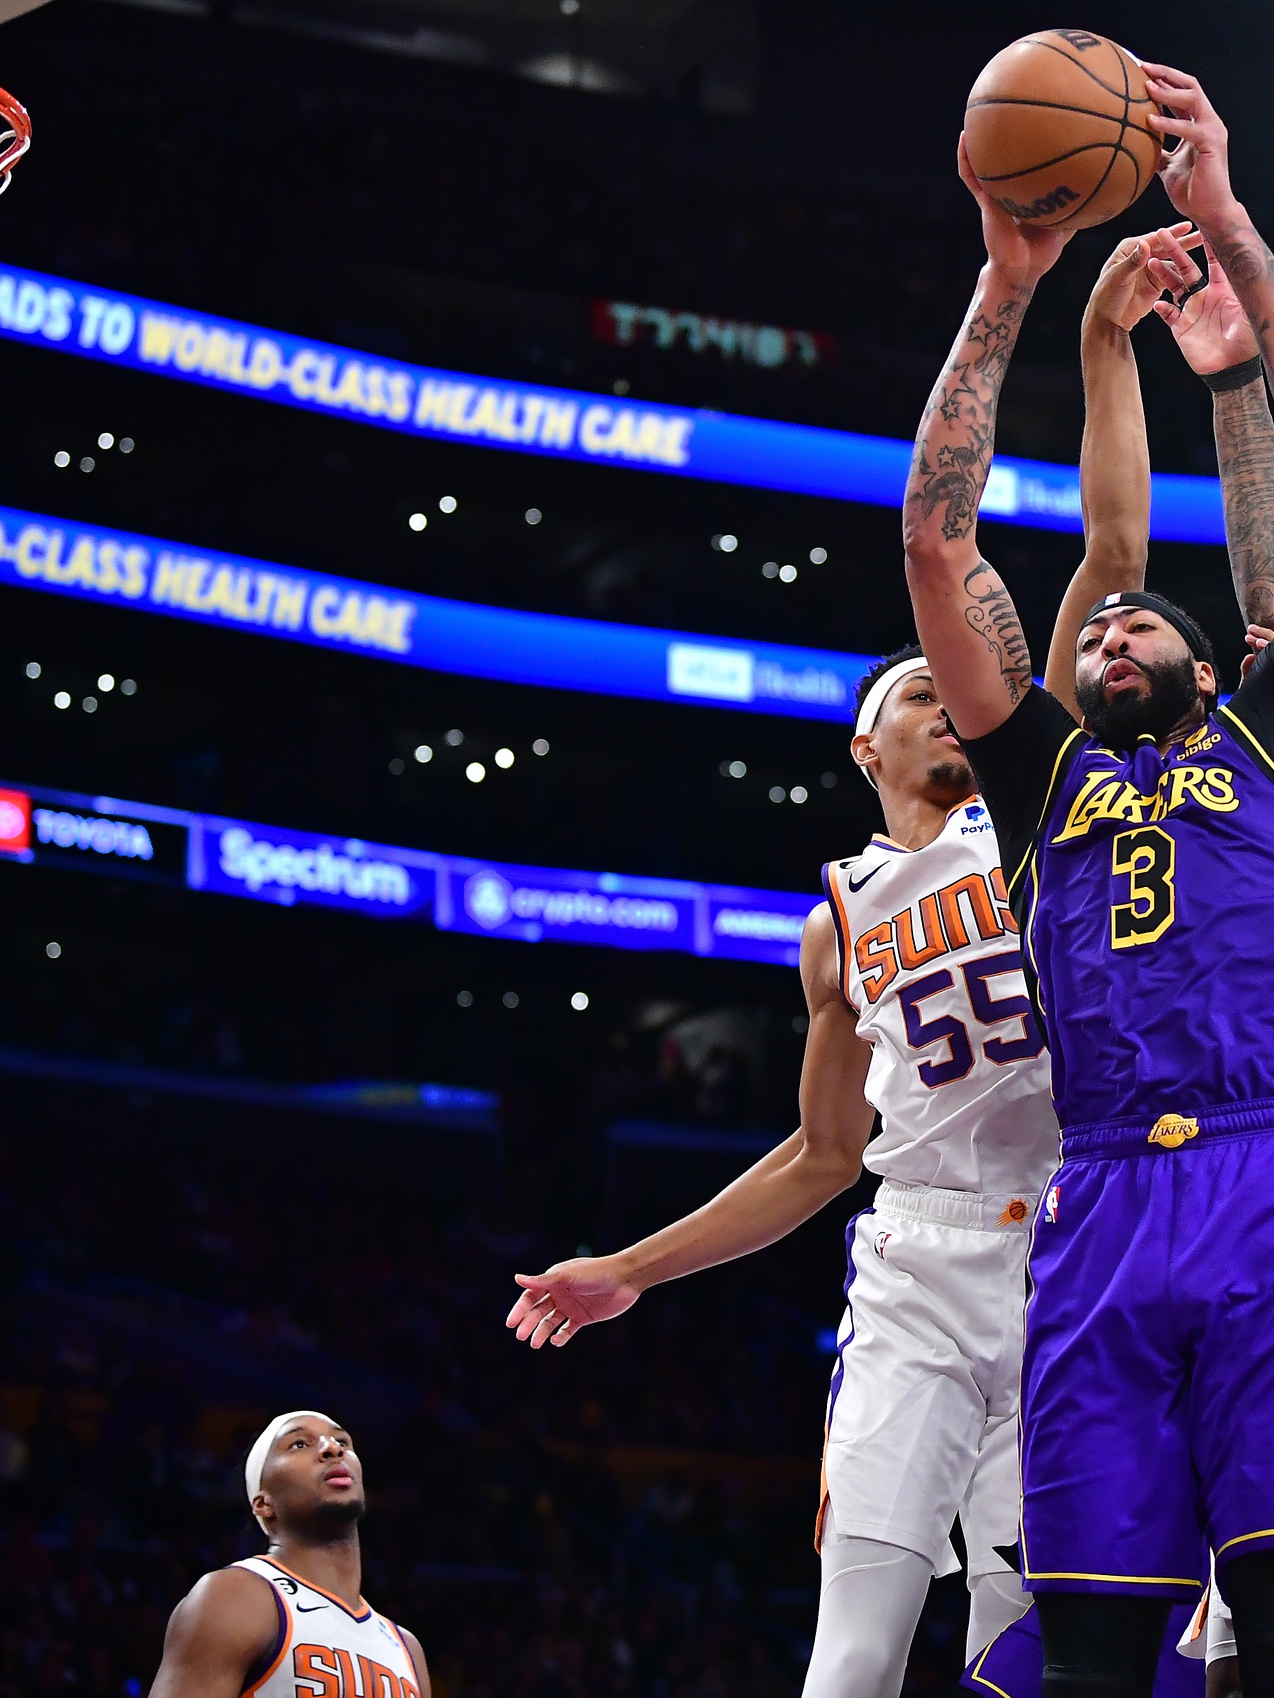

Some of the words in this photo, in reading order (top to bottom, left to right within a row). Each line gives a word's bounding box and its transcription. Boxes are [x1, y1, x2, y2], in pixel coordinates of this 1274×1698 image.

[79, 295, 135, 356] TO
[138, 313, 414, 424] WORLD-CLASS
[414, 378, 579, 448] HEALTH
[581, 408, 691, 467] CARE
[0, 523, 151, 599] -CLASS
[152, 551, 308, 630] HEALTH
[309, 584, 416, 654] CARE
[1176, 733, 1222, 761] bibigo
[32, 807, 154, 861] TOYOTA
[960, 821, 996, 836] PayP
[1051, 766, 1240, 844] LAKERS
[219, 827, 411, 906] Spectrum
[1111, 825, 1176, 951] 3
[510, 886, 678, 933] crypto.com
[895, 949, 1047, 1090] 55
[1152, 1124, 1194, 1141] LAKERS
